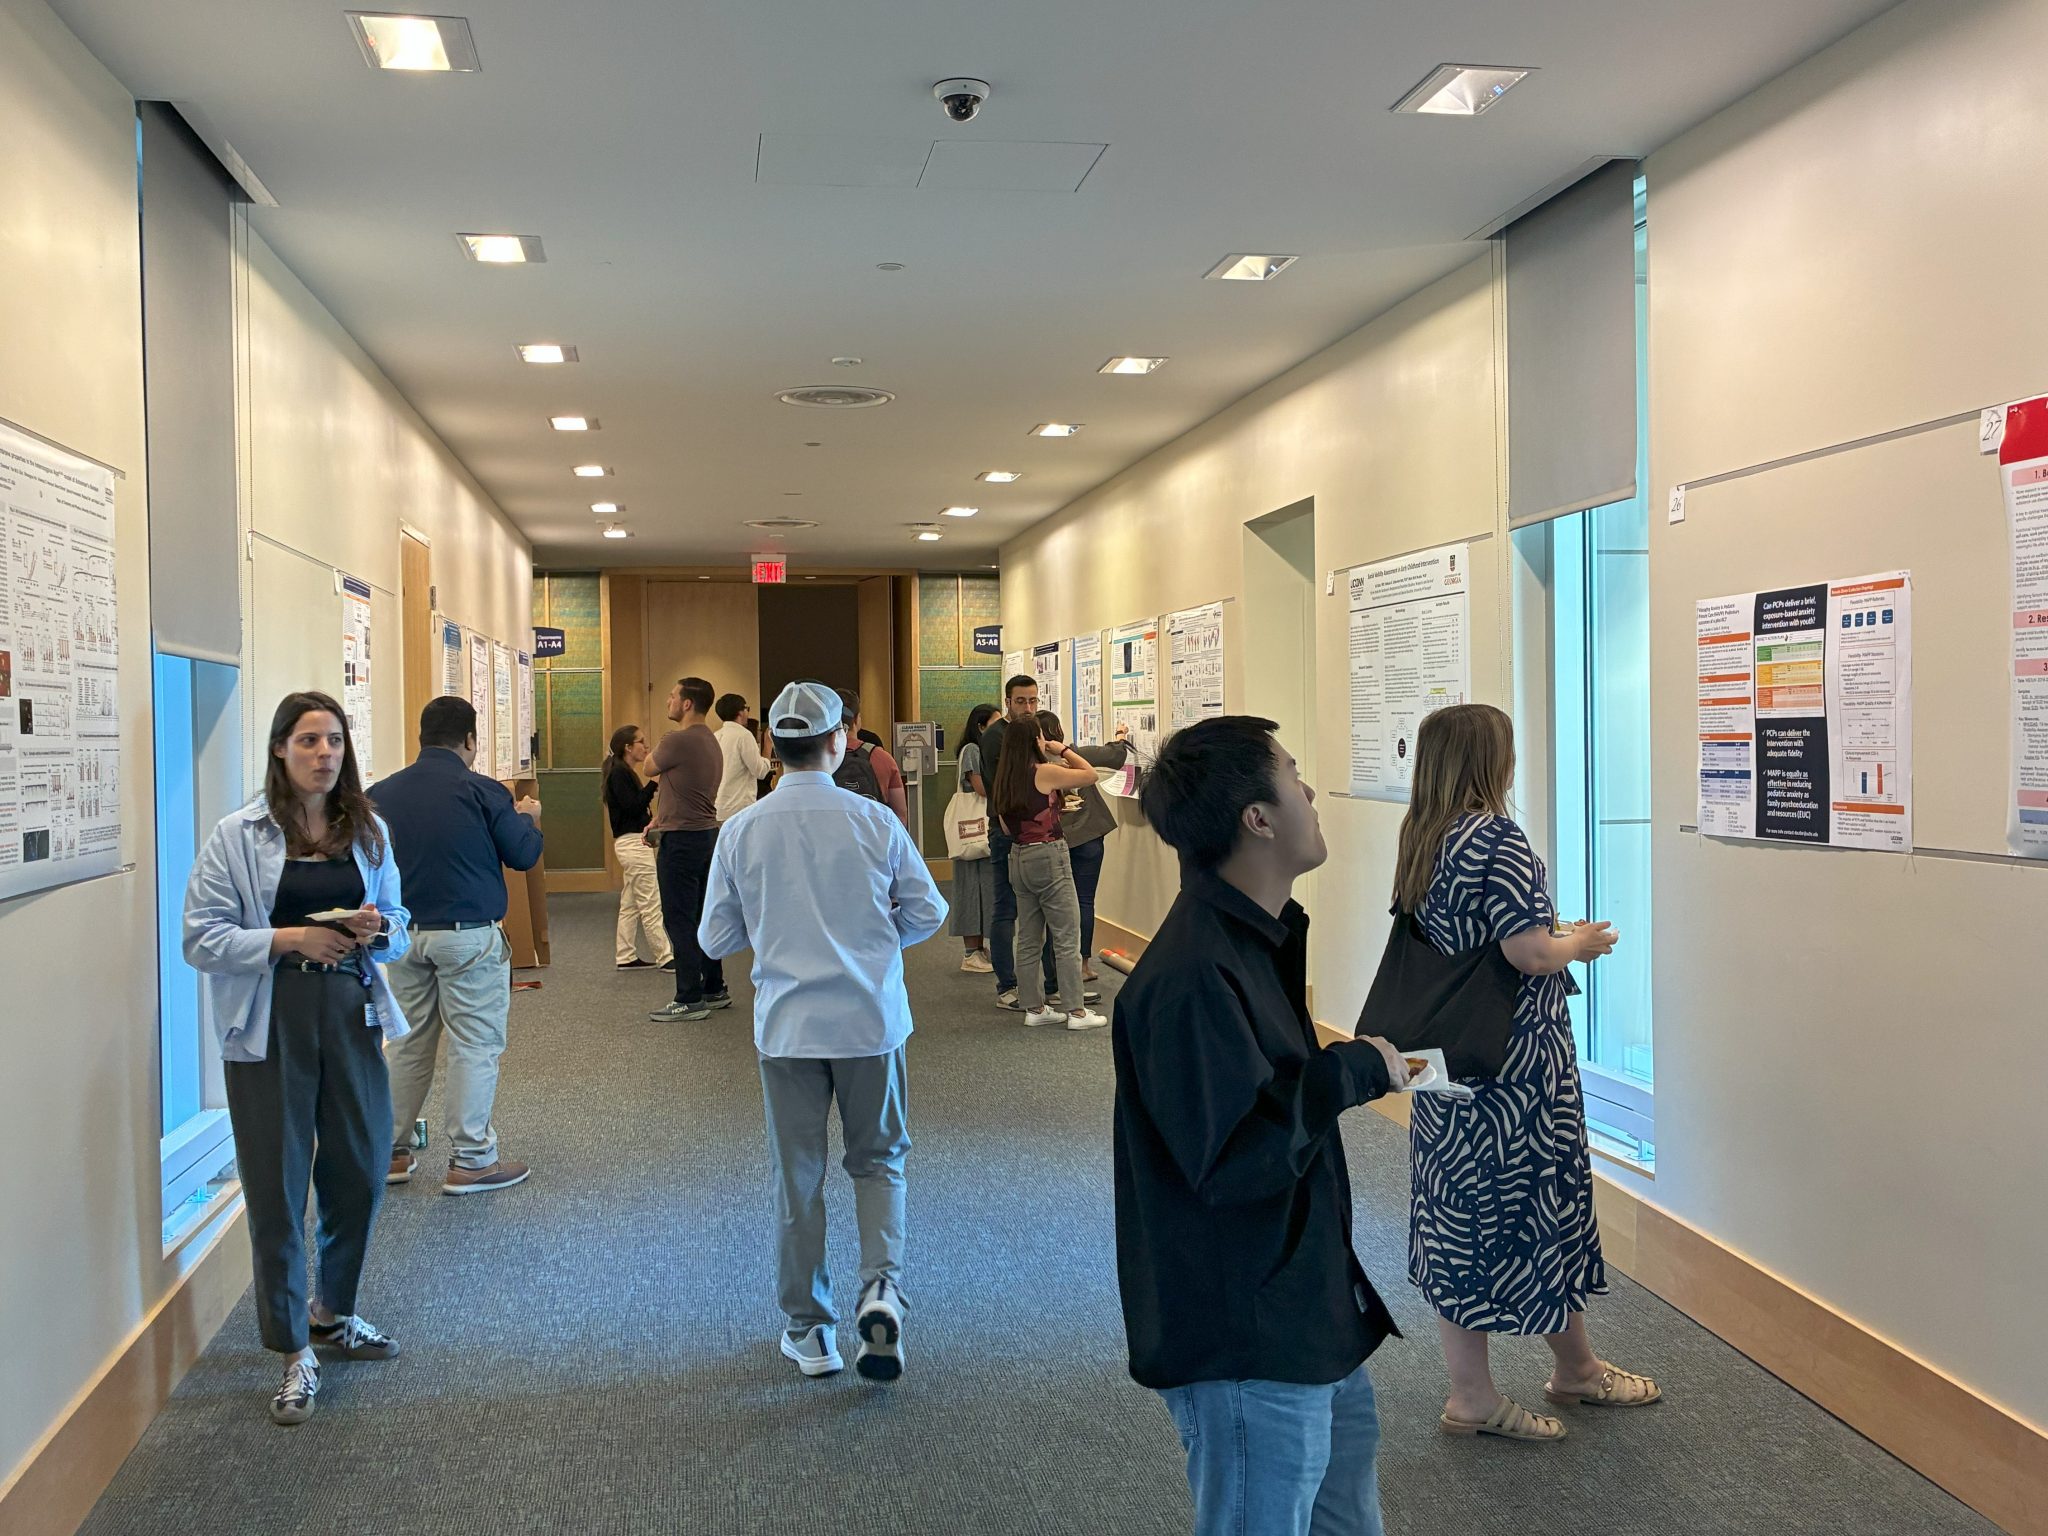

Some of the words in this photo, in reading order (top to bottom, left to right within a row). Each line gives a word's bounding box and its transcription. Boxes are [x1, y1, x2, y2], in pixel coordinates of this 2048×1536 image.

[1982, 420, 2001, 441] 27
[757, 562, 782, 583] EXIT
[1785, 599, 1800, 607] deliver
[1763, 608, 1798, 620] exposure-based
[1799, 608, 1815, 616] anxiety
[1762, 620, 1788, 629] intervention
[1800, 617, 1816, 627] youth?
[2028, 615, 2035, 624] 2.
[1788, 750, 1803, 758] fidelity
[1786, 770, 1802, 778] equally
[1767, 780, 1786, 788] effective
[1792, 780, 1812, 789] reducing
[1787, 791, 1803, 799] anxiety
[1767, 800, 1780, 808] family
[1781, 800, 1818, 809] psychoeducation
[1797, 811, 1811, 819] (EUC)
